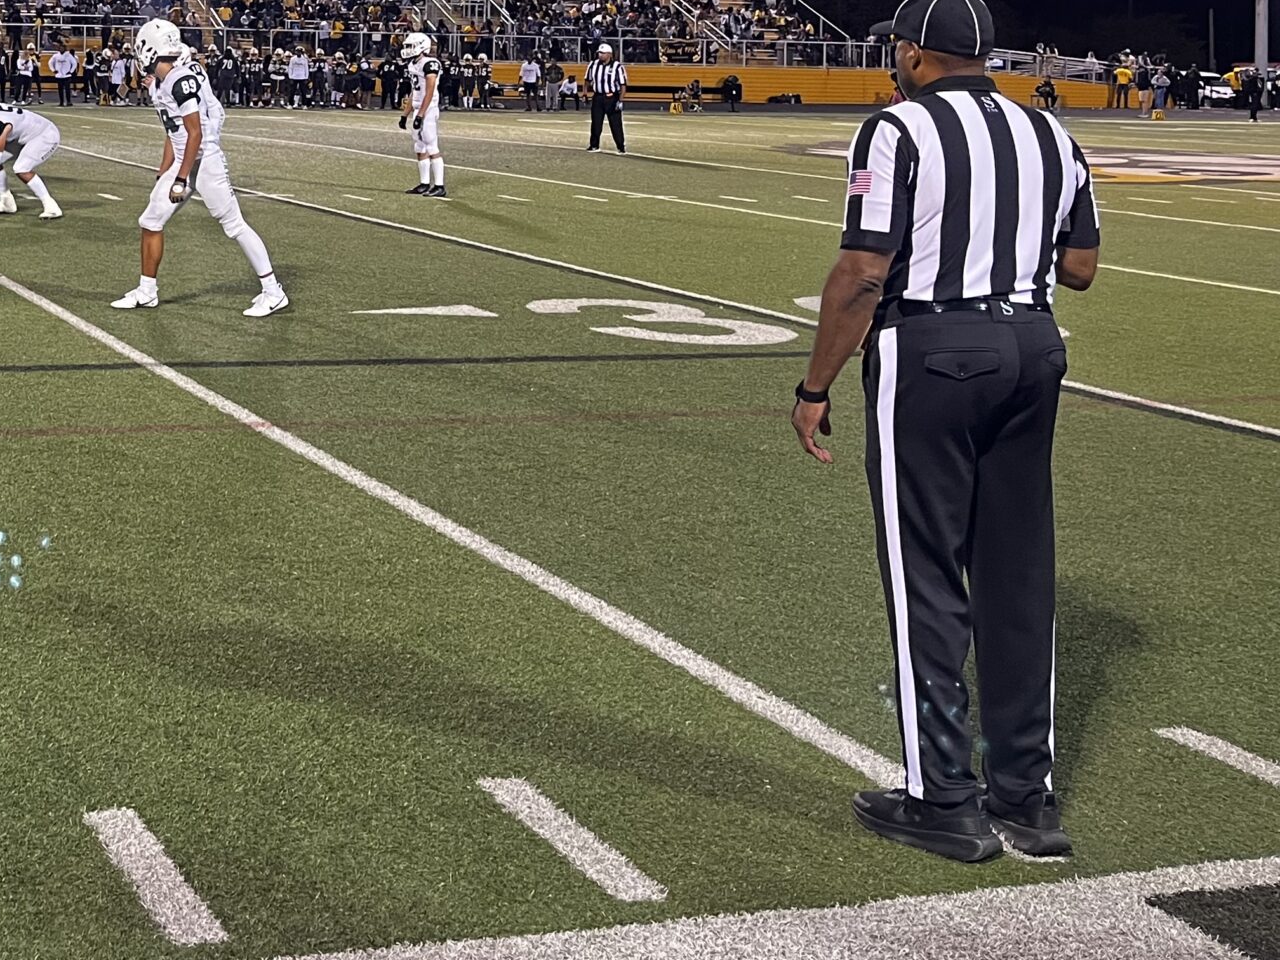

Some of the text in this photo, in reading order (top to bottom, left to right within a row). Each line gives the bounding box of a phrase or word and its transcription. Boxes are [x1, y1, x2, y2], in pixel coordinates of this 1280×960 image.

[222, 59, 233, 70] 70
[429, 62, 440, 71] 32
[181, 79, 197, 95] 89
[672, 103, 684, 114] 40
[525, 298, 799, 346] 3
